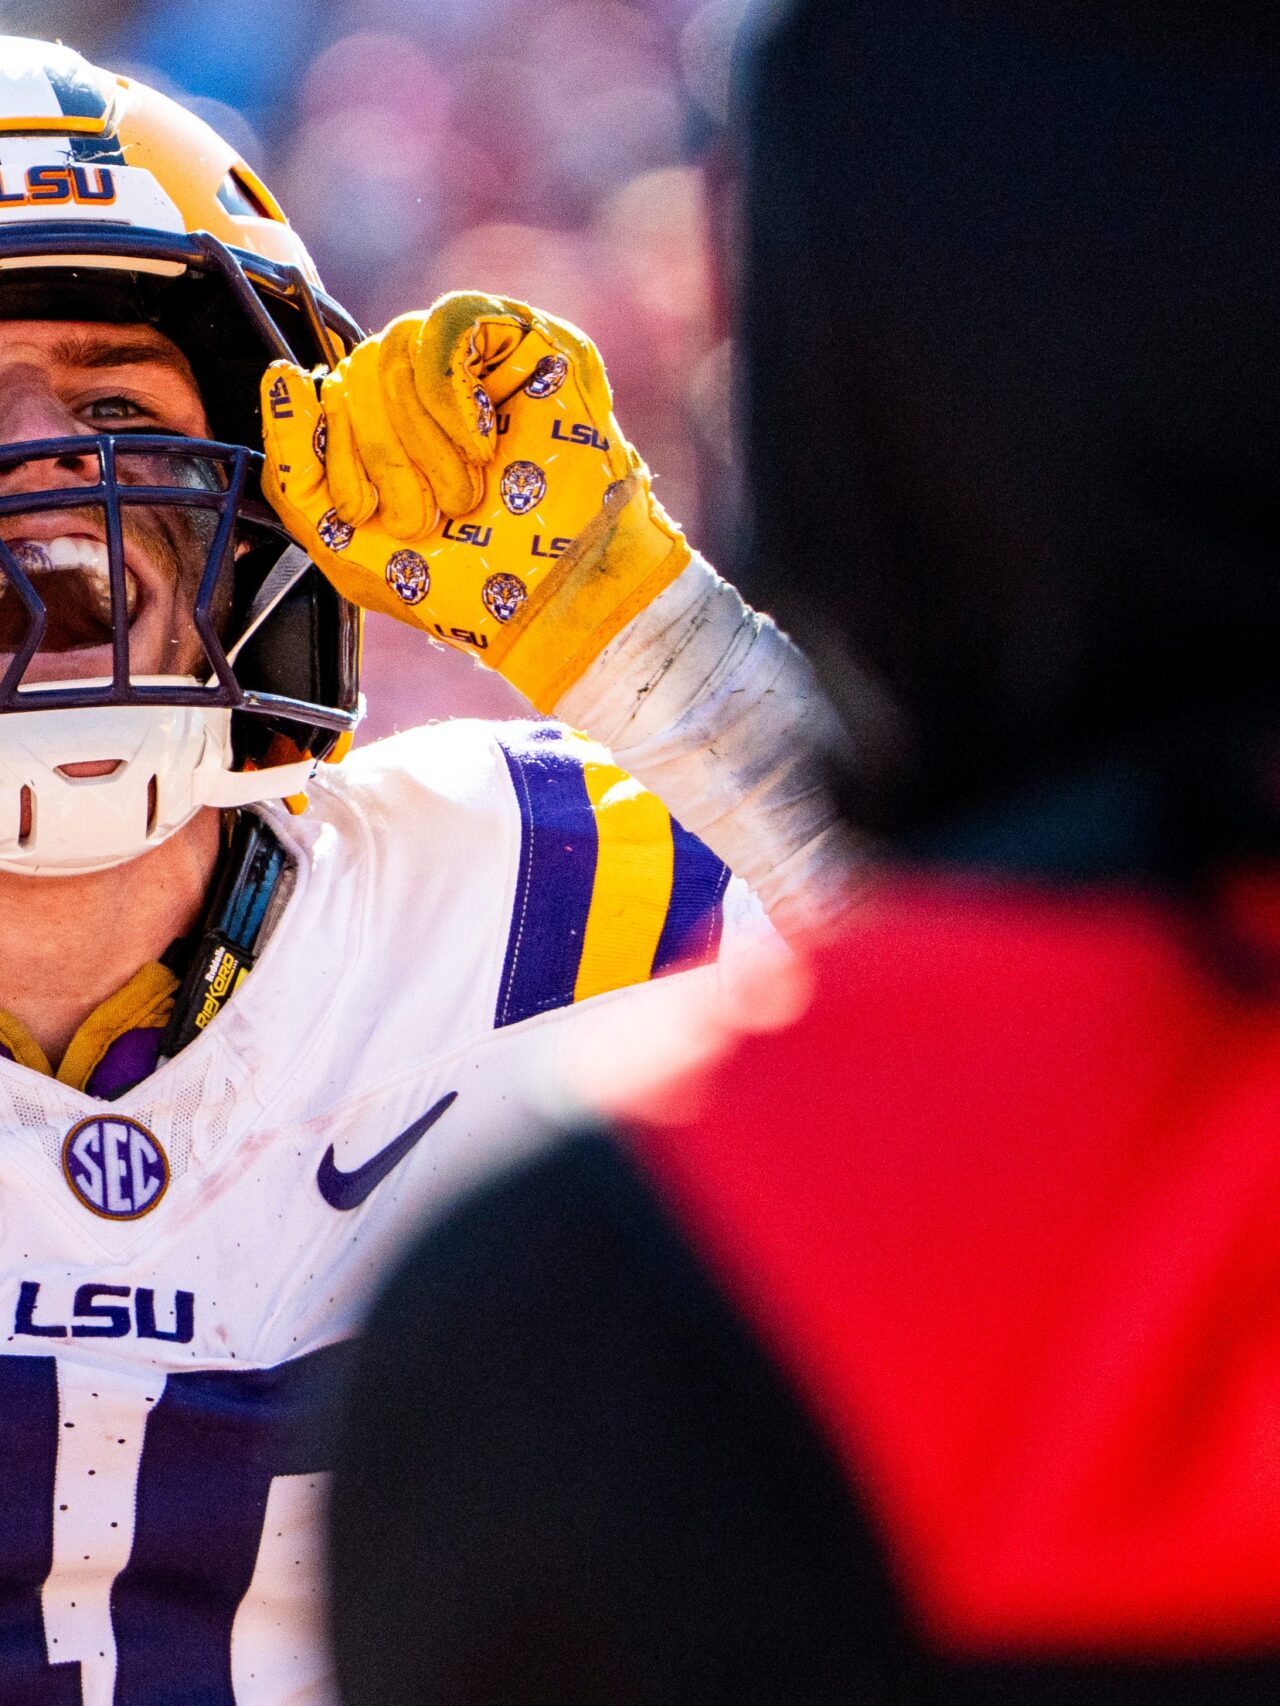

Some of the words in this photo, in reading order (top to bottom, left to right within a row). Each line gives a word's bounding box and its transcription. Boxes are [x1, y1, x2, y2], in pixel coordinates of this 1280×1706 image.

[552, 419, 610, 452] LSU
[441, 518, 493, 547] LSU
[531, 534, 575, 560] LS
[433, 623, 488, 650] LSU
[72, 1121, 161, 1212] SEC
[14, 1280, 195, 1344] LSU
